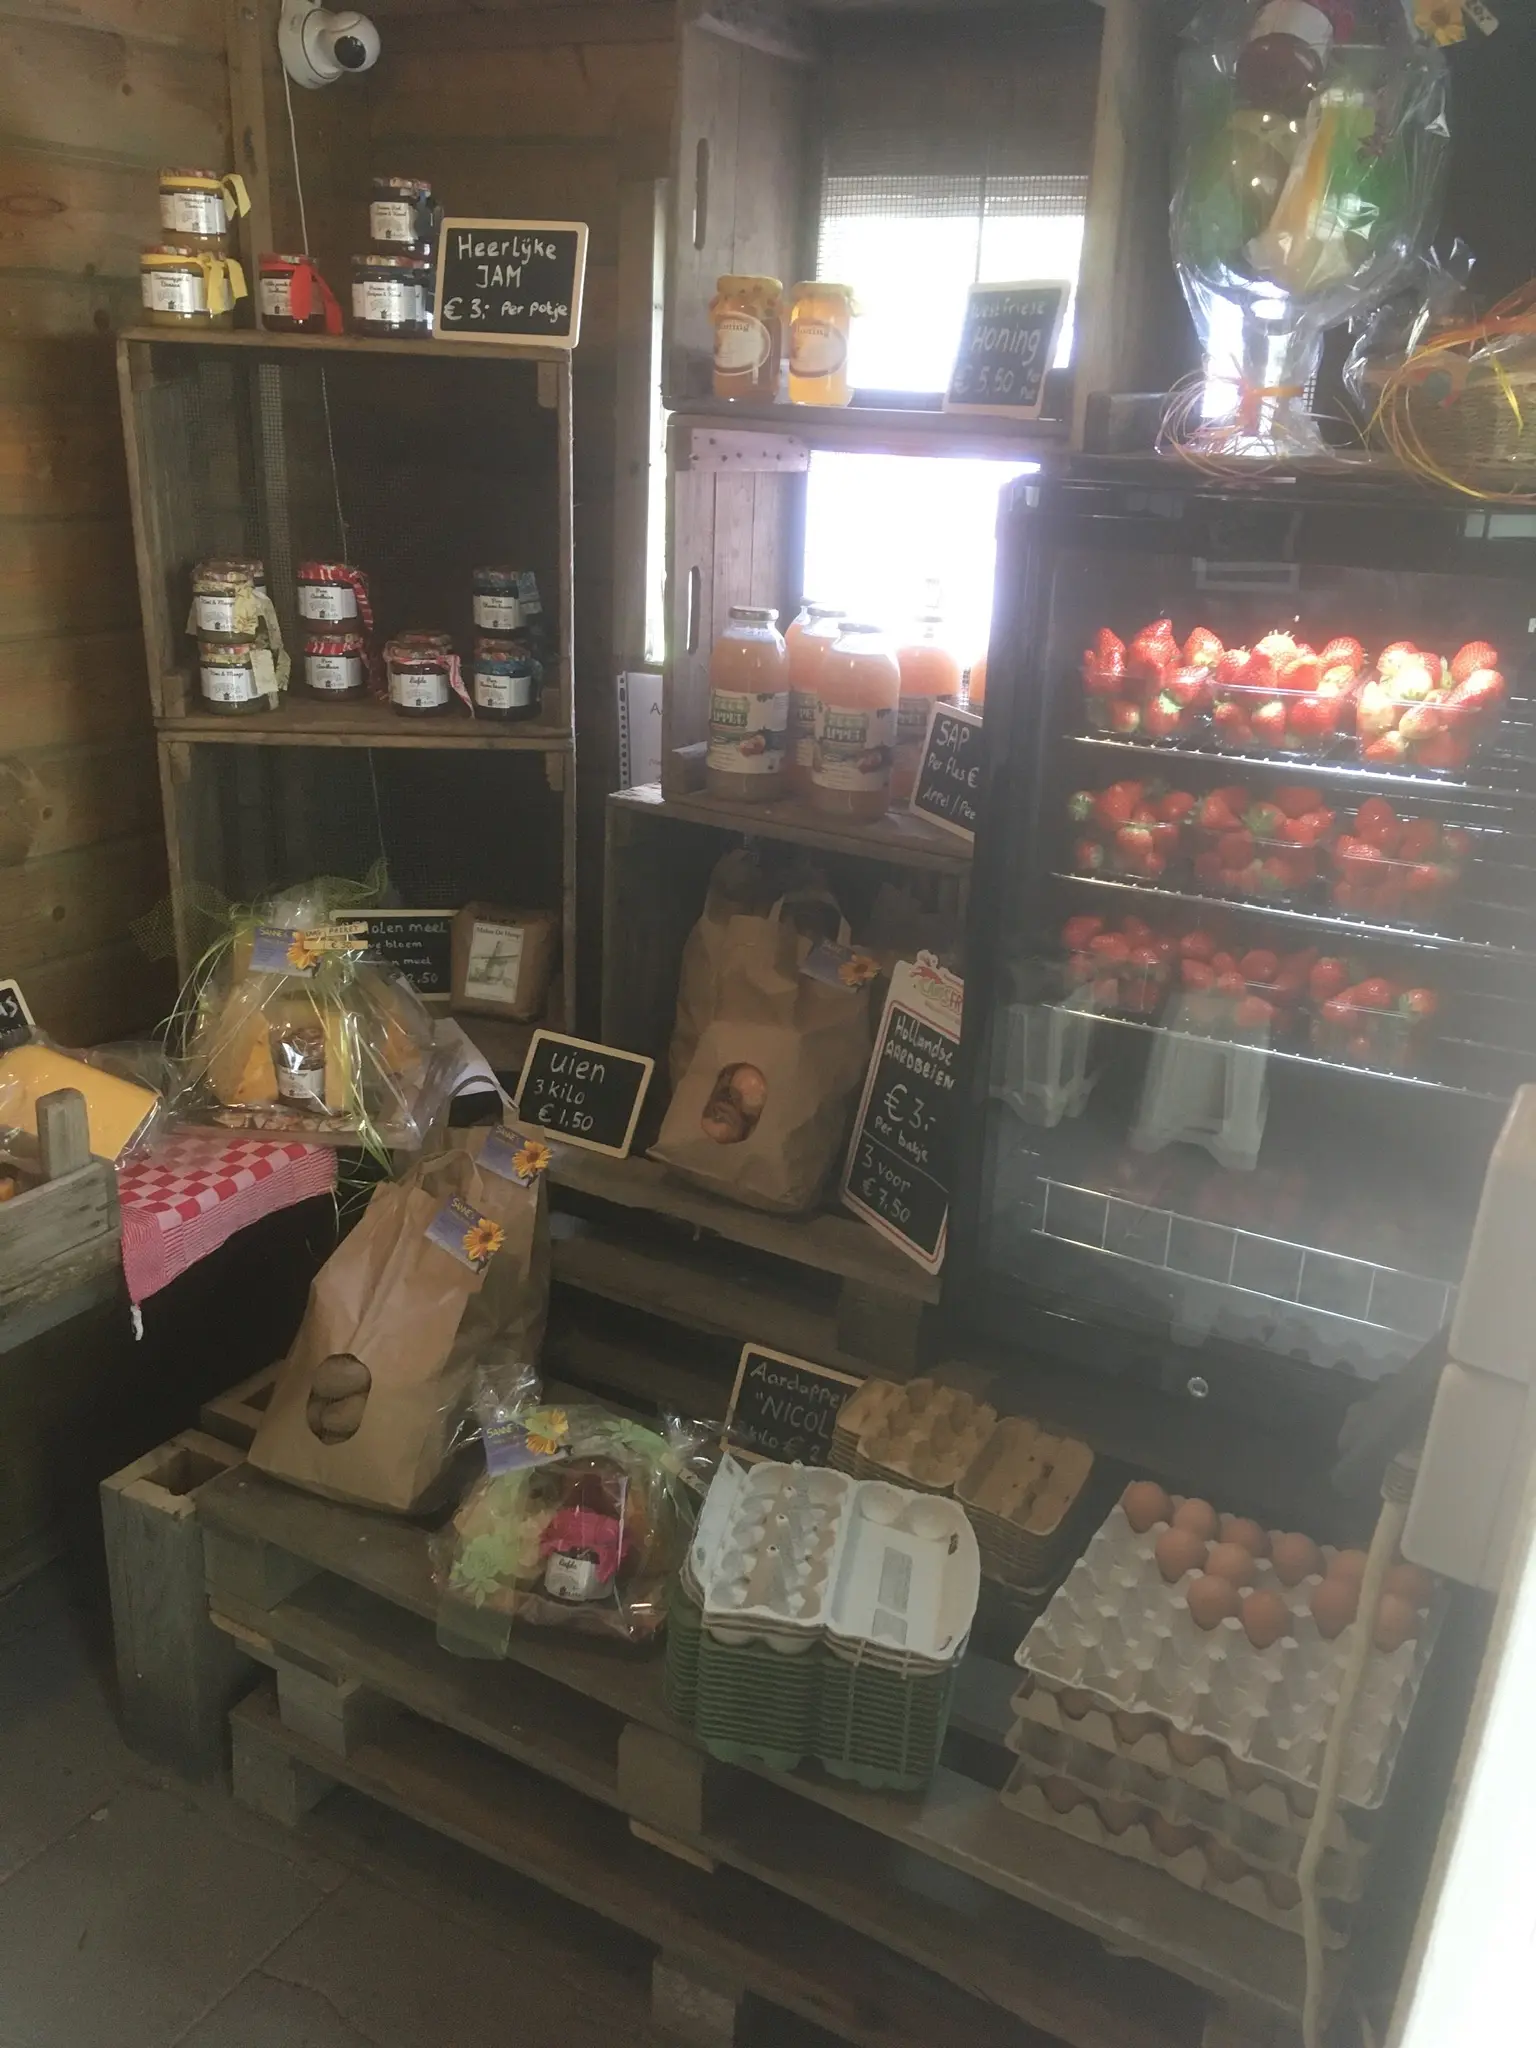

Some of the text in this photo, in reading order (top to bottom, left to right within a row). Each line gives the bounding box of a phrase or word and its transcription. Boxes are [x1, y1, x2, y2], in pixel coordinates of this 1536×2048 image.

[476, 265, 522, 288] JAM
[443, 297, 462, 320] €
[971, 324, 1042, 367] Honing
[936, 720, 970, 753] SAP
[895, 1015, 954, 1067] Hollandse
[533, 1079, 544, 1095] 3
[884, 1083, 908, 1122] €
[538, 1103, 594, 1131] € 1,50
[862, 1143, 912, 1193] 3 voor
[862, 1177, 912, 1223] € 7,50
